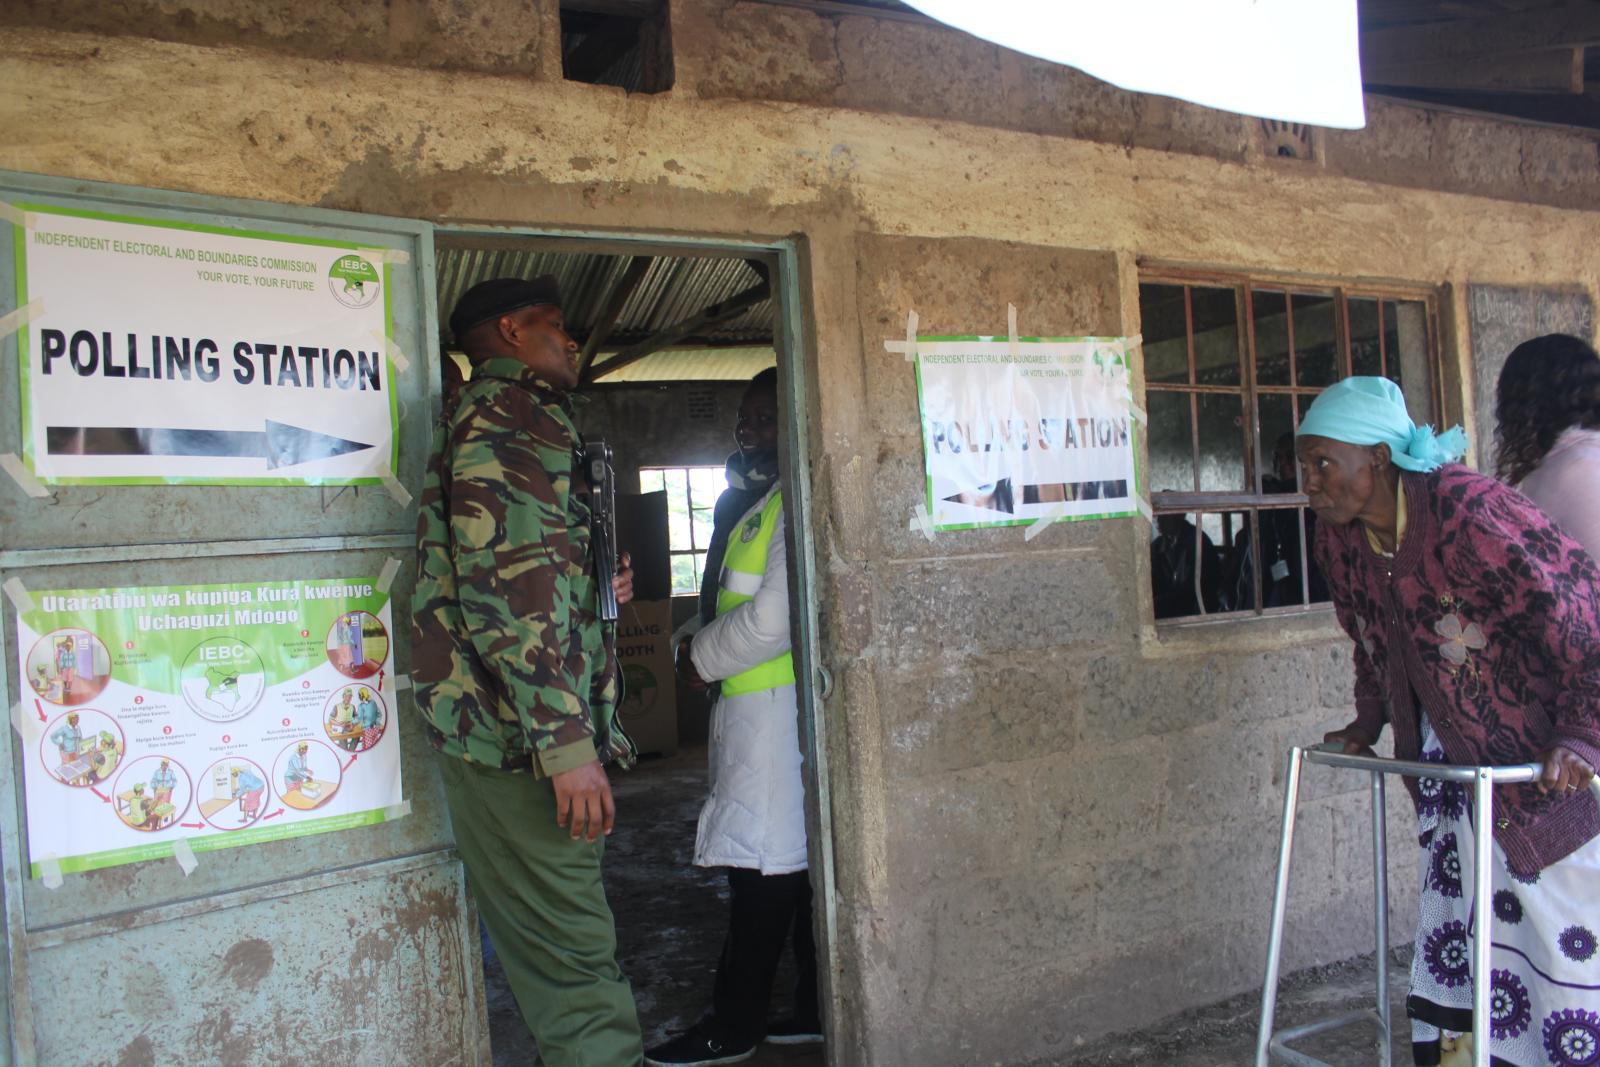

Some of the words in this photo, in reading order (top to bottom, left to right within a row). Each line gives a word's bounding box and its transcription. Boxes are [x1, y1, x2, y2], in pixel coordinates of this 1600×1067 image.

[34, 232, 110, 251] INDEPENDENT
[113, 240, 173, 258] ELECTORAL
[175, 248, 195, 260] AND
[197, 250, 259, 267] BOUNDARIES
[261, 257, 317, 273] COMMISSION
[340, 259, 368, 271] IEBC
[197, 270, 223, 281] YOUR
[225, 272, 252, 286] VOTE,
[253, 276, 279, 288] YOUR
[280, 279, 315, 291] FUTURE
[41, 329, 220, 383] POLLING
[233, 341, 381, 391] STATION
[42, 593, 146, 613] Utaratibu
[150, 594, 180, 608] wa
[186, 588, 252, 608] kupiga
[257, 585, 300, 604] Kura
[304, 582, 372, 601] kwenye
[138, 610, 230, 631] Uchaguzi
[235, 609, 298, 628] Mdogo
[618, 625, 659, 638] LLING
[200, 644, 244, 660] IEBC
[616, 645, 654, 658] OOTH
